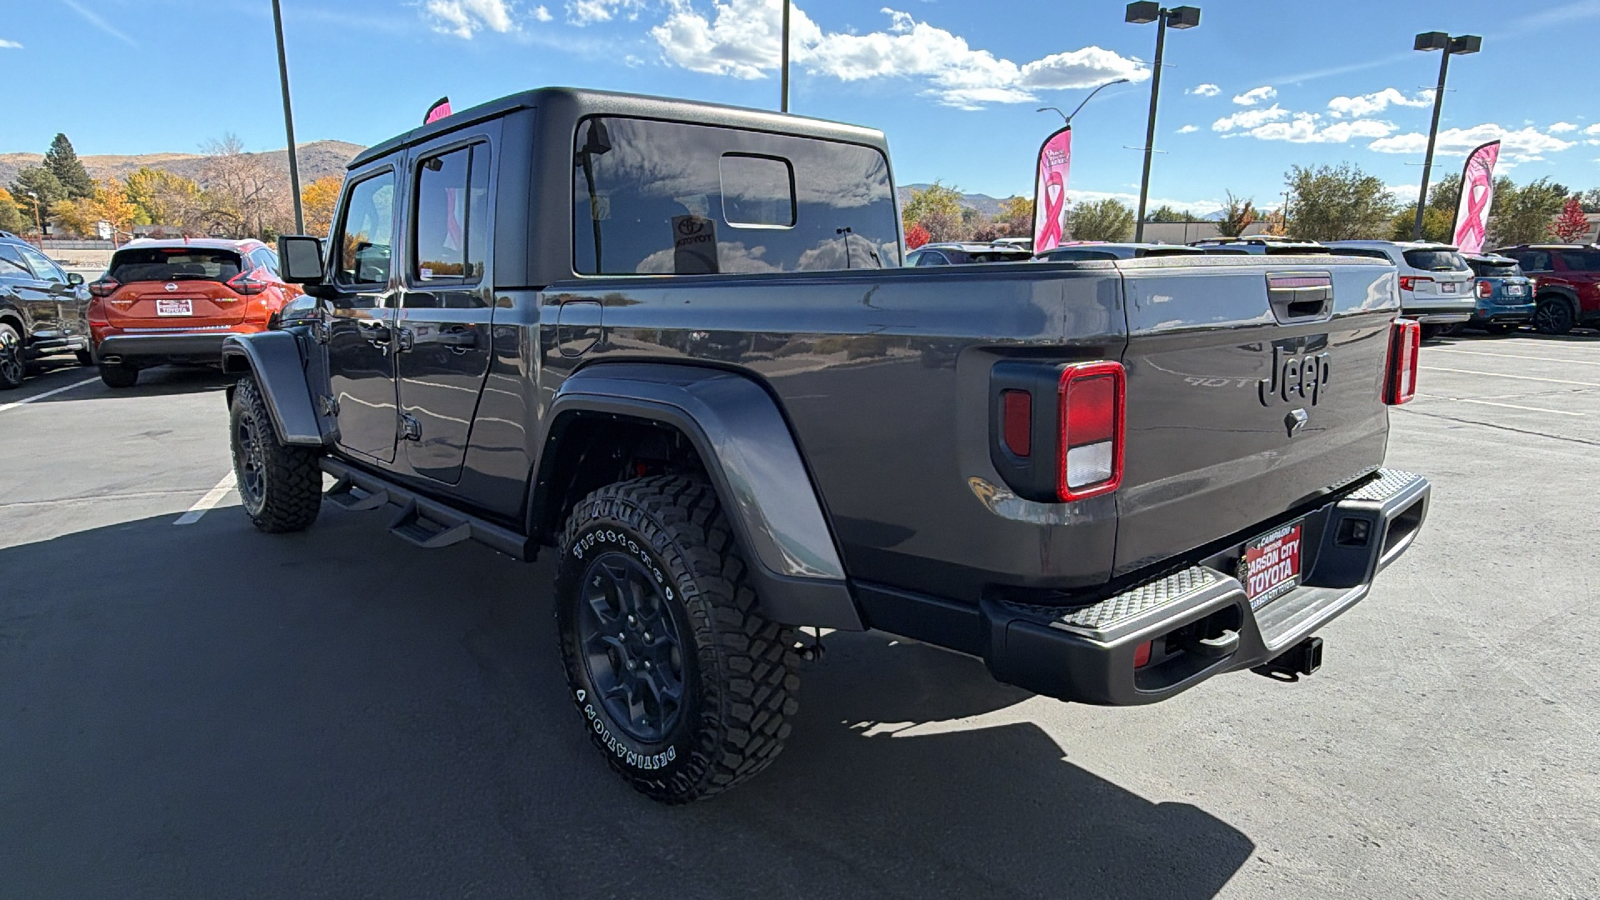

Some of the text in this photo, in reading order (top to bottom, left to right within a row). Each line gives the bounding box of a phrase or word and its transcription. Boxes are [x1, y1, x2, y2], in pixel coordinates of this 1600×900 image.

[1258, 346, 1331, 407] Jeep
[572, 529, 663, 584] Firestone
[1249, 558, 1292, 596] TOYOTA
[1281, 539, 1300, 560] CITY
[584, 704, 676, 770] DESTINATION
